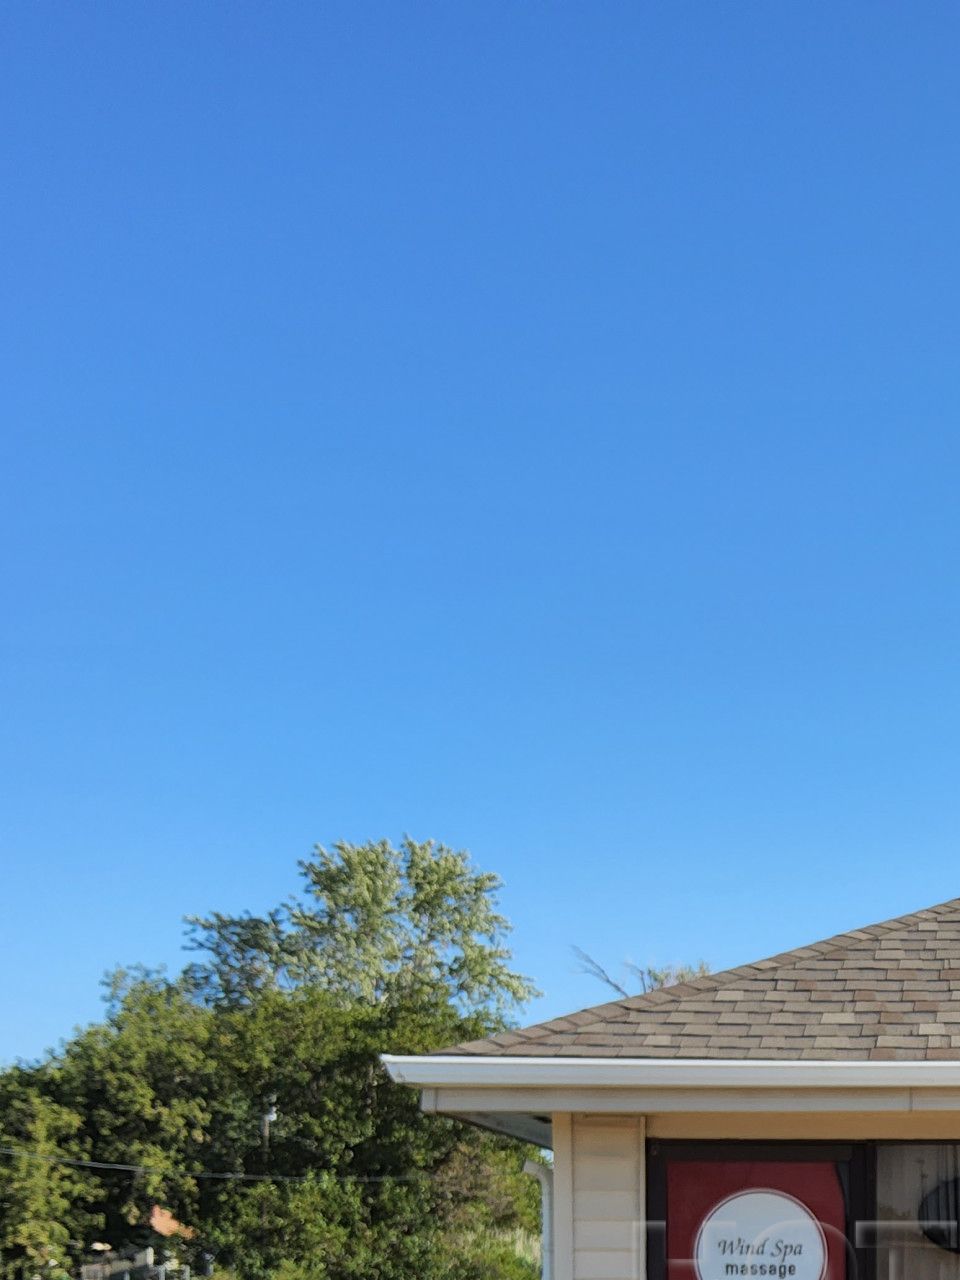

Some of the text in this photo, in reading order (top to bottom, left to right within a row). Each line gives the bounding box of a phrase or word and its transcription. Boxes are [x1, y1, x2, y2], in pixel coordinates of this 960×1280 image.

[718, 1237, 803, 1263] Wind Spa
[725, 1262, 796, 1280] massage
